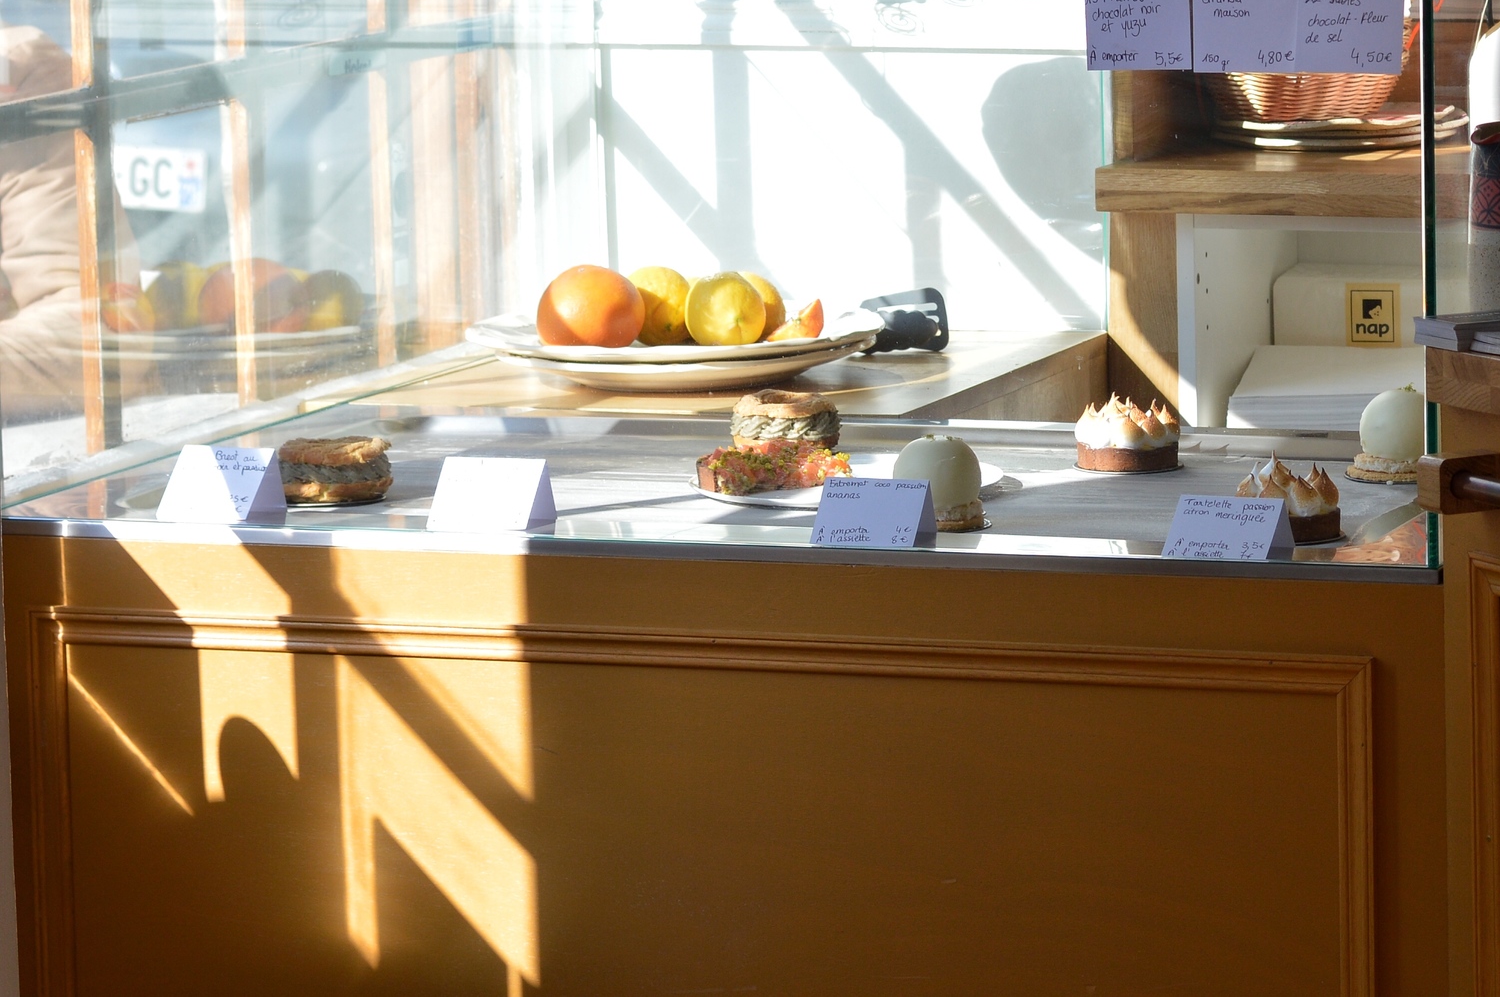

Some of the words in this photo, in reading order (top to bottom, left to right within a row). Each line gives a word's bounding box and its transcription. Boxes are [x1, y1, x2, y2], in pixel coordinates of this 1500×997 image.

[1092, 4, 1134, 22] chocolat
[1140, 1, 1161, 14] noir
[1213, 6, 1251, 19] maison
[1307, 11, 1351, 28] chocolat
[1101, 21, 1114, 33] et
[1120, 17, 1147, 39] yuzu
[1305, 31, 1320, 44] de
[1327, 30, 1343, 43] sel
[1101, 49, 1139, 66] emporter
[1202, 54, 1220, 64] 150
[1221, 59, 1230, 71] gr
[1350, 47, 1392, 68] 4,50€
[1355, 323, 1390, 338] nap
[214, 463, 229, 471] oir
[232, 461, 241, 471] et
[241, 465, 268, 476] passio
[829, 479, 869, 489] Entremet
[895, 482, 927, 491] passion
[826, 491, 861, 499] ananas
[1184, 498, 1232, 509] Tartelette
[1242, 503, 1276, 514] passion
[1215, 511, 1266, 527] meringuée
[830, 525, 870, 538] emporter
[1188, 540, 1230, 551] emporter
